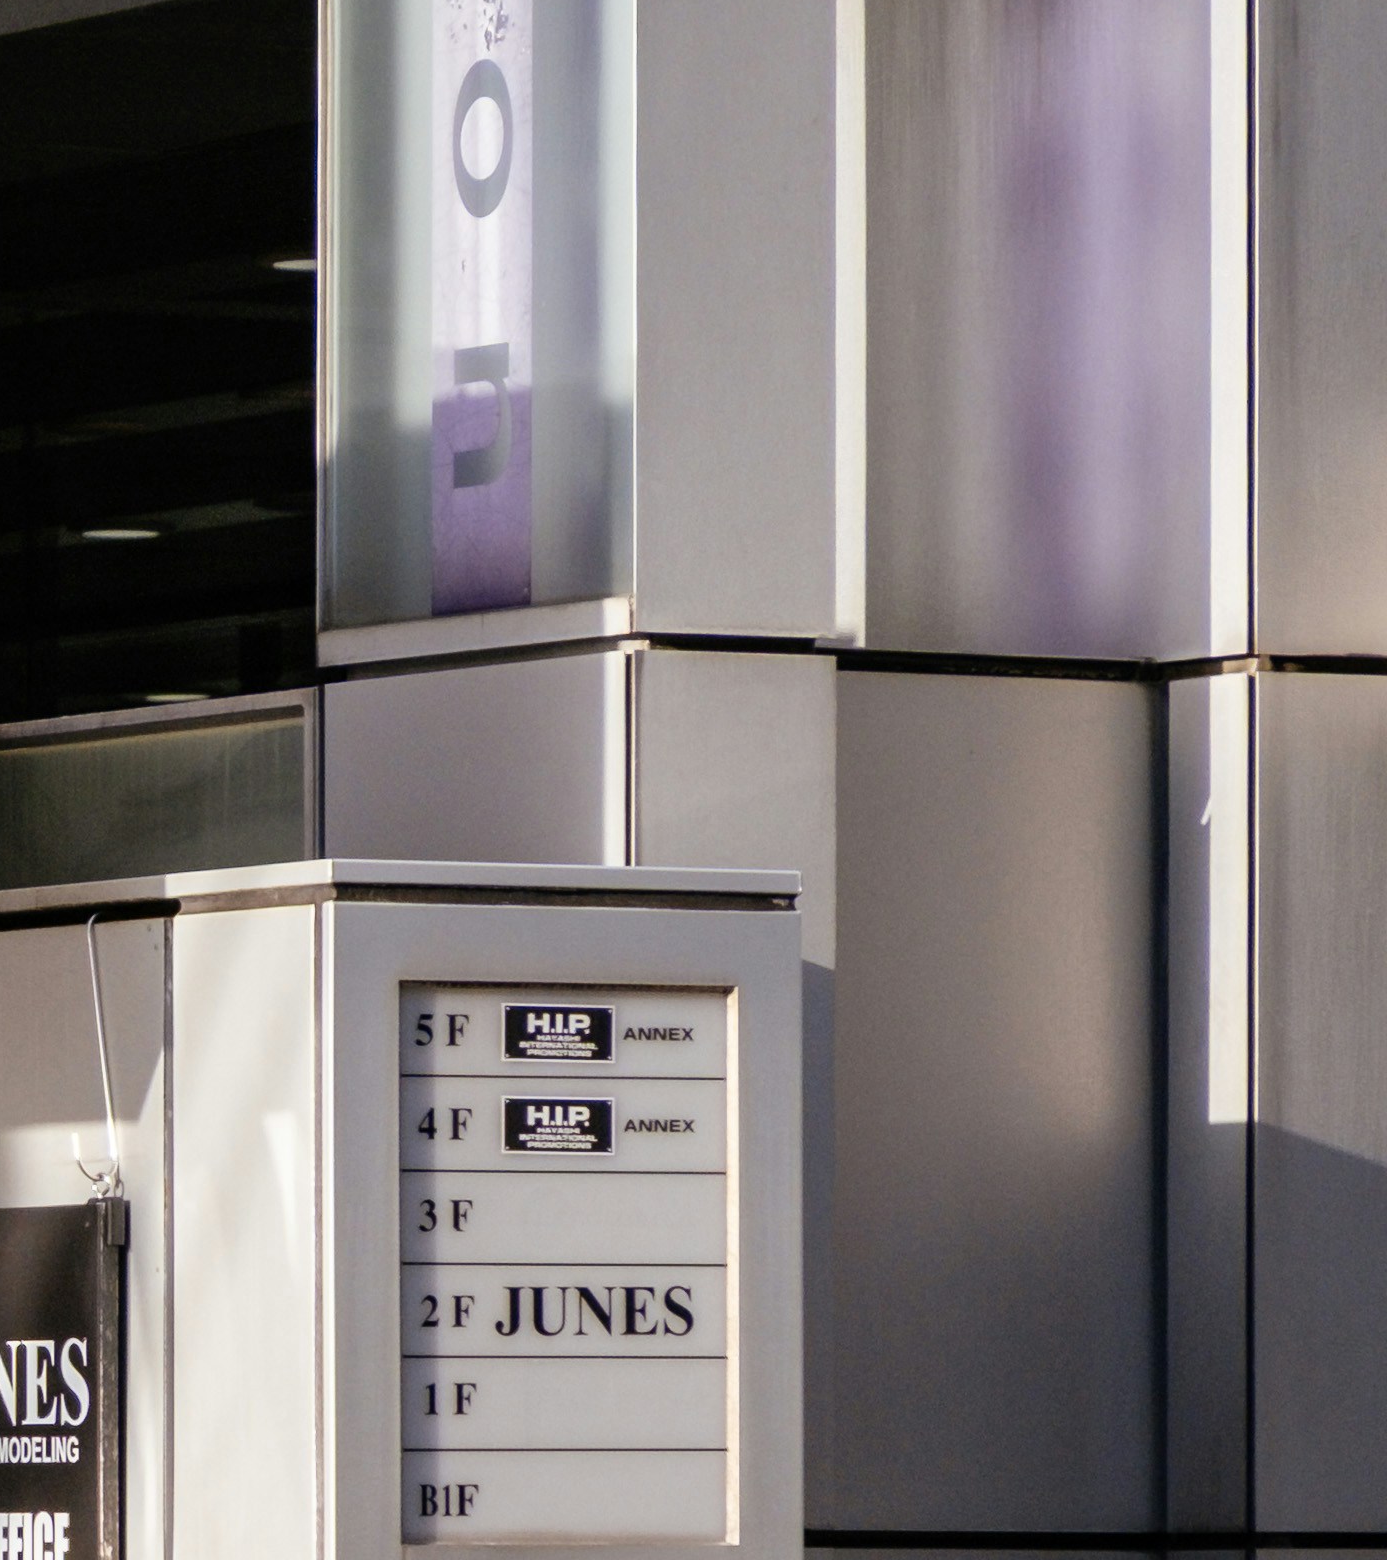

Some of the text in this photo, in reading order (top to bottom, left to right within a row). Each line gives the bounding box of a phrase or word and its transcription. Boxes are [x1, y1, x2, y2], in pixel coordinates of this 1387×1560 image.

[527, 1013, 592, 1035] H.I.P.
[623, 1027, 695, 1042] ANNEX
[518, 1041, 599, 1051] INTERNATIONAL
[527, 1049, 593, 1058] PROMOTIONS
[527, 1105, 591, 1127] H.I.P.
[623, 1119, 696, 1134] ANNEX
[518, 1134, 598, 1143] INTERNATIONAL
[526, 1141, 593, 1150] PROMOTIONS
[495, 1285, 695, 1337] JUNES
[418, 1484, 480, 1517] B1F
